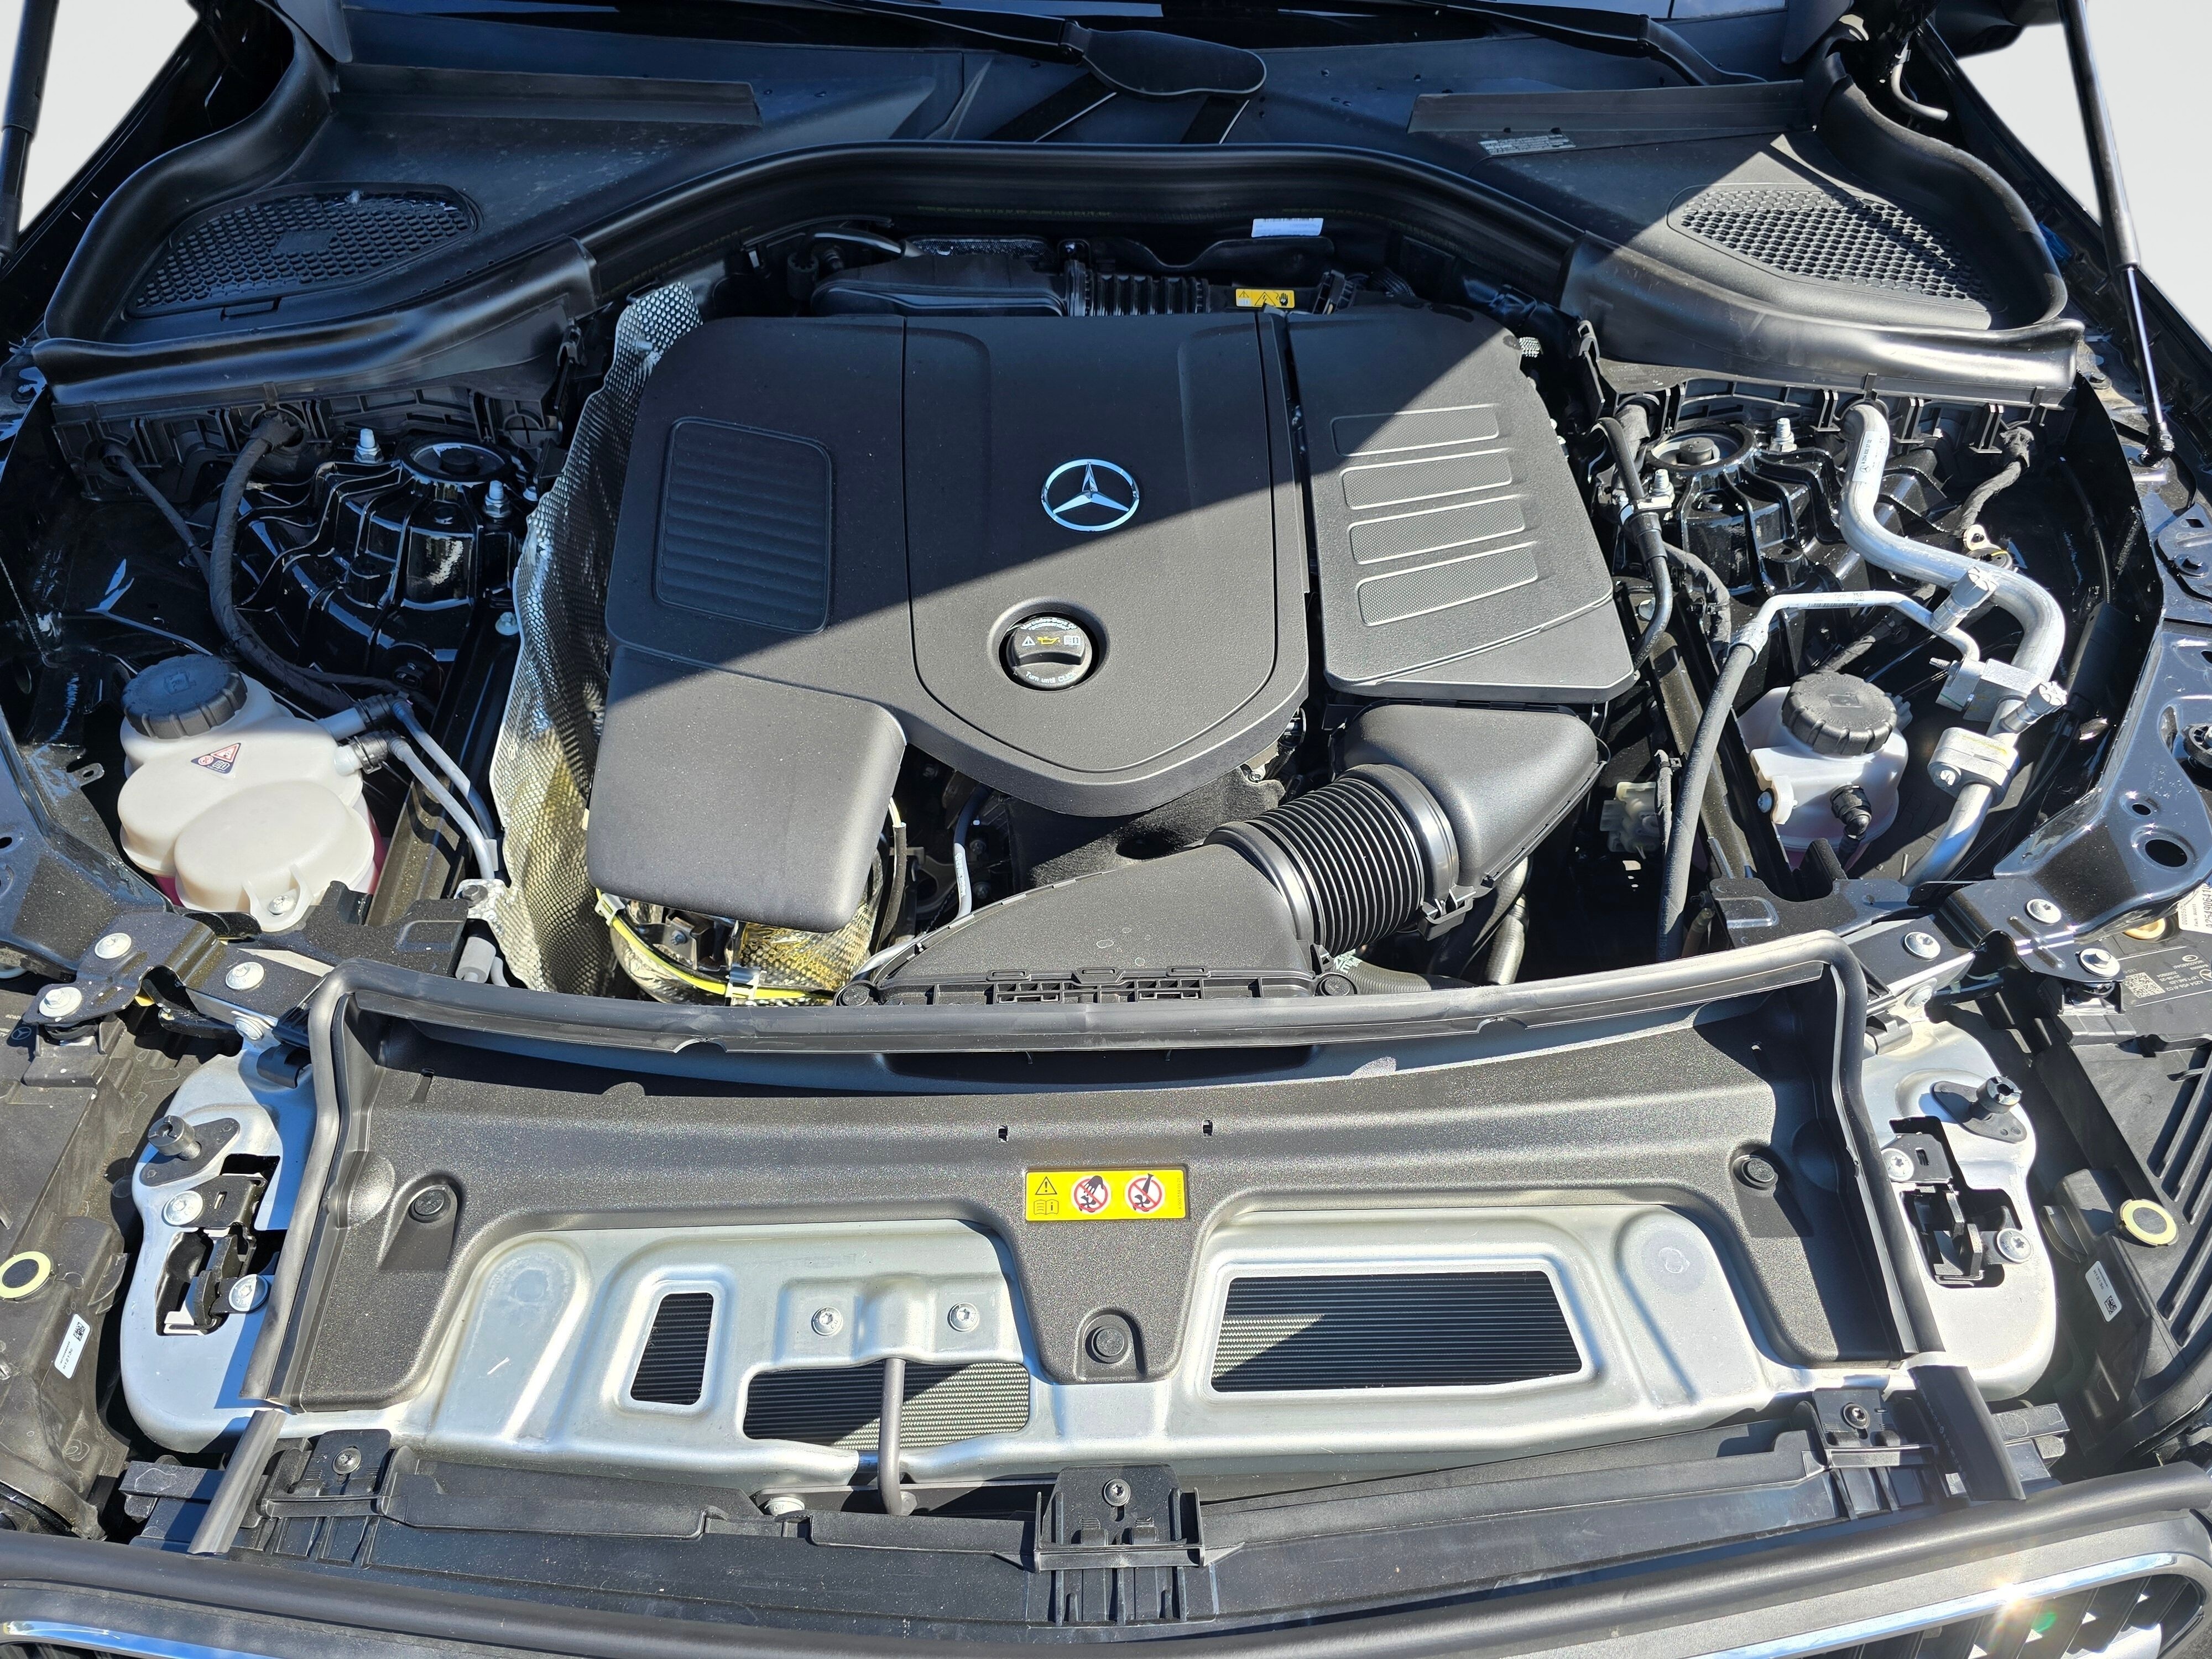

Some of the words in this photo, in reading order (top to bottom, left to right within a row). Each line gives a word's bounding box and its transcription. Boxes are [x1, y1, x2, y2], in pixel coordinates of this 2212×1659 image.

[1020, 617, 1068, 630] Mercedes-Benz
[1025, 671, 1039, 682] Turn
[1058, 670, 1077, 682] CLICK
